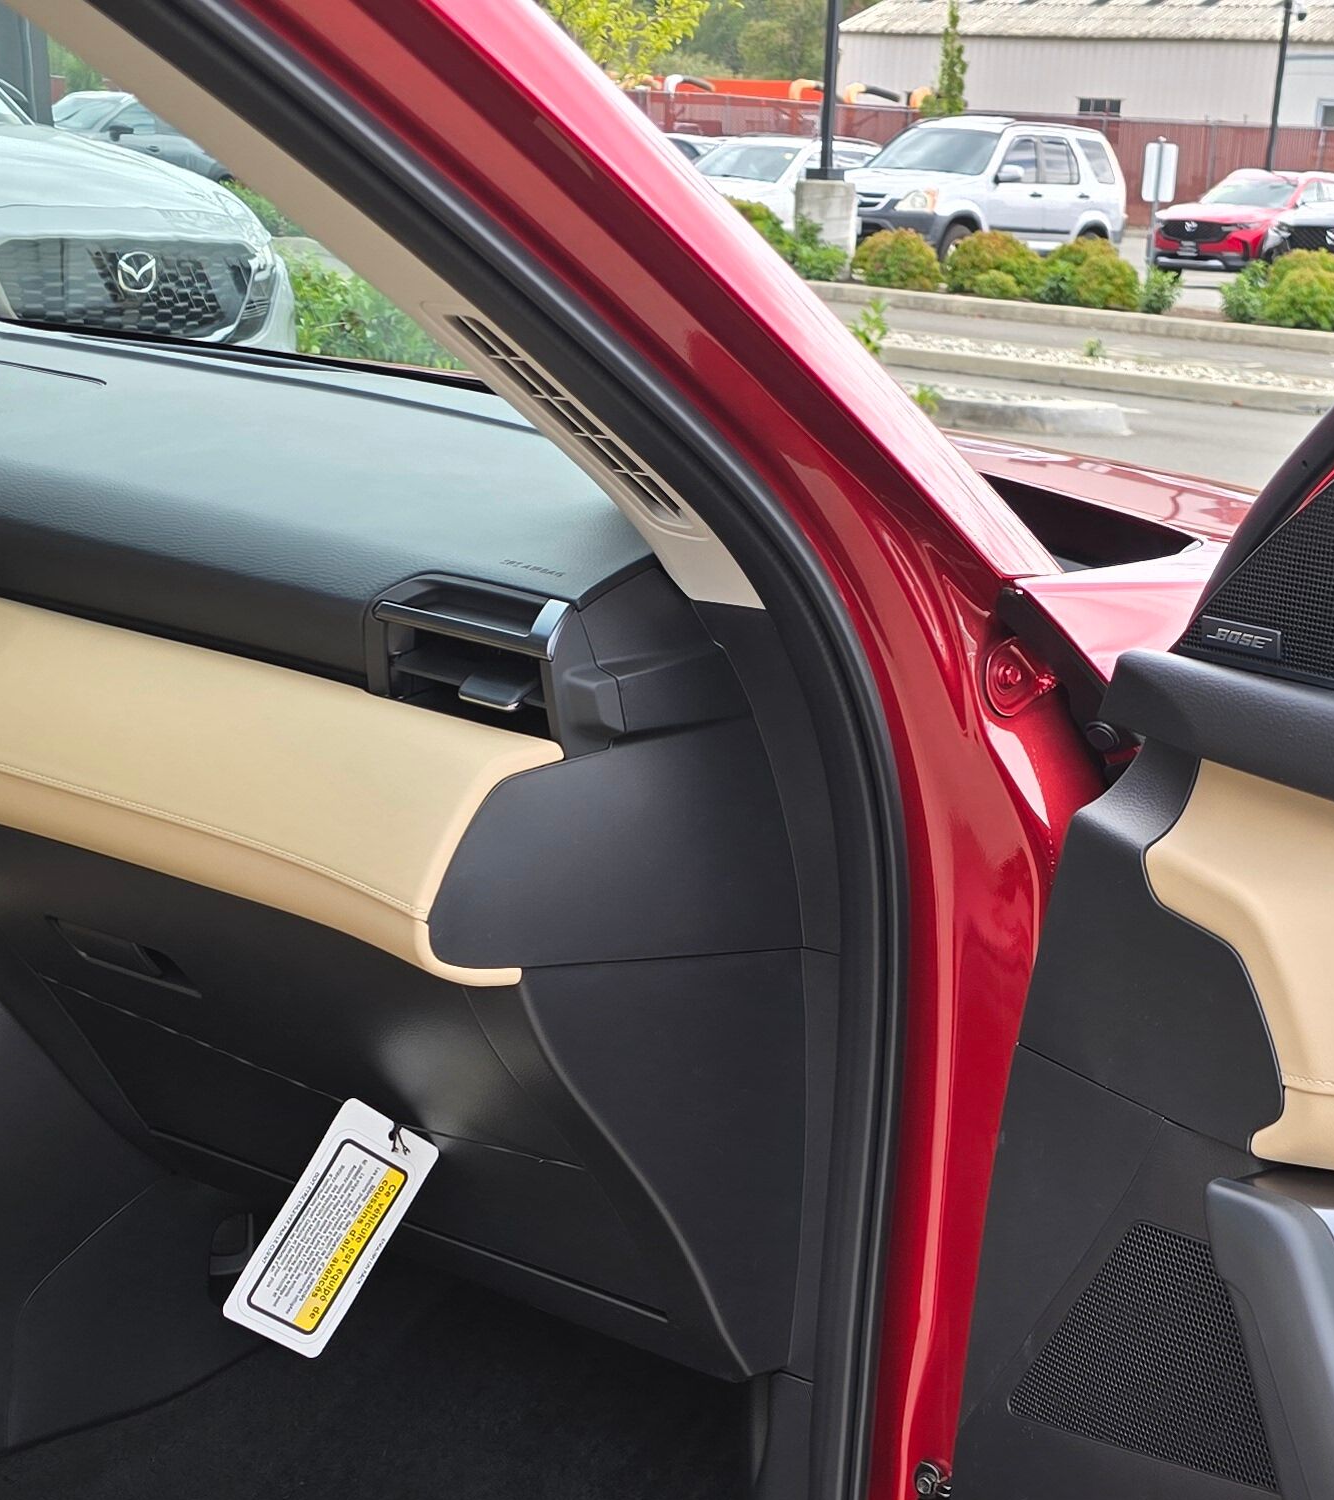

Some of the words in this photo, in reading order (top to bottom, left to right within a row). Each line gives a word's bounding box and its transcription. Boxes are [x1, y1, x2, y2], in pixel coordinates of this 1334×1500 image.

[1206, 628, 1273, 649] BOSE
[355, 1177, 389, 1226] coussins
[383, 1182, 397, 1199] Ce
[354, 1200, 386, 1245] véhicule
[338, 1228, 357, 1253] d'air
[341, 1246, 356, 1265] est
[310, 1256, 340, 1299] avancés
[317, 1266, 345, 1303] équipé
[308, 1305, 321, 1321] de
